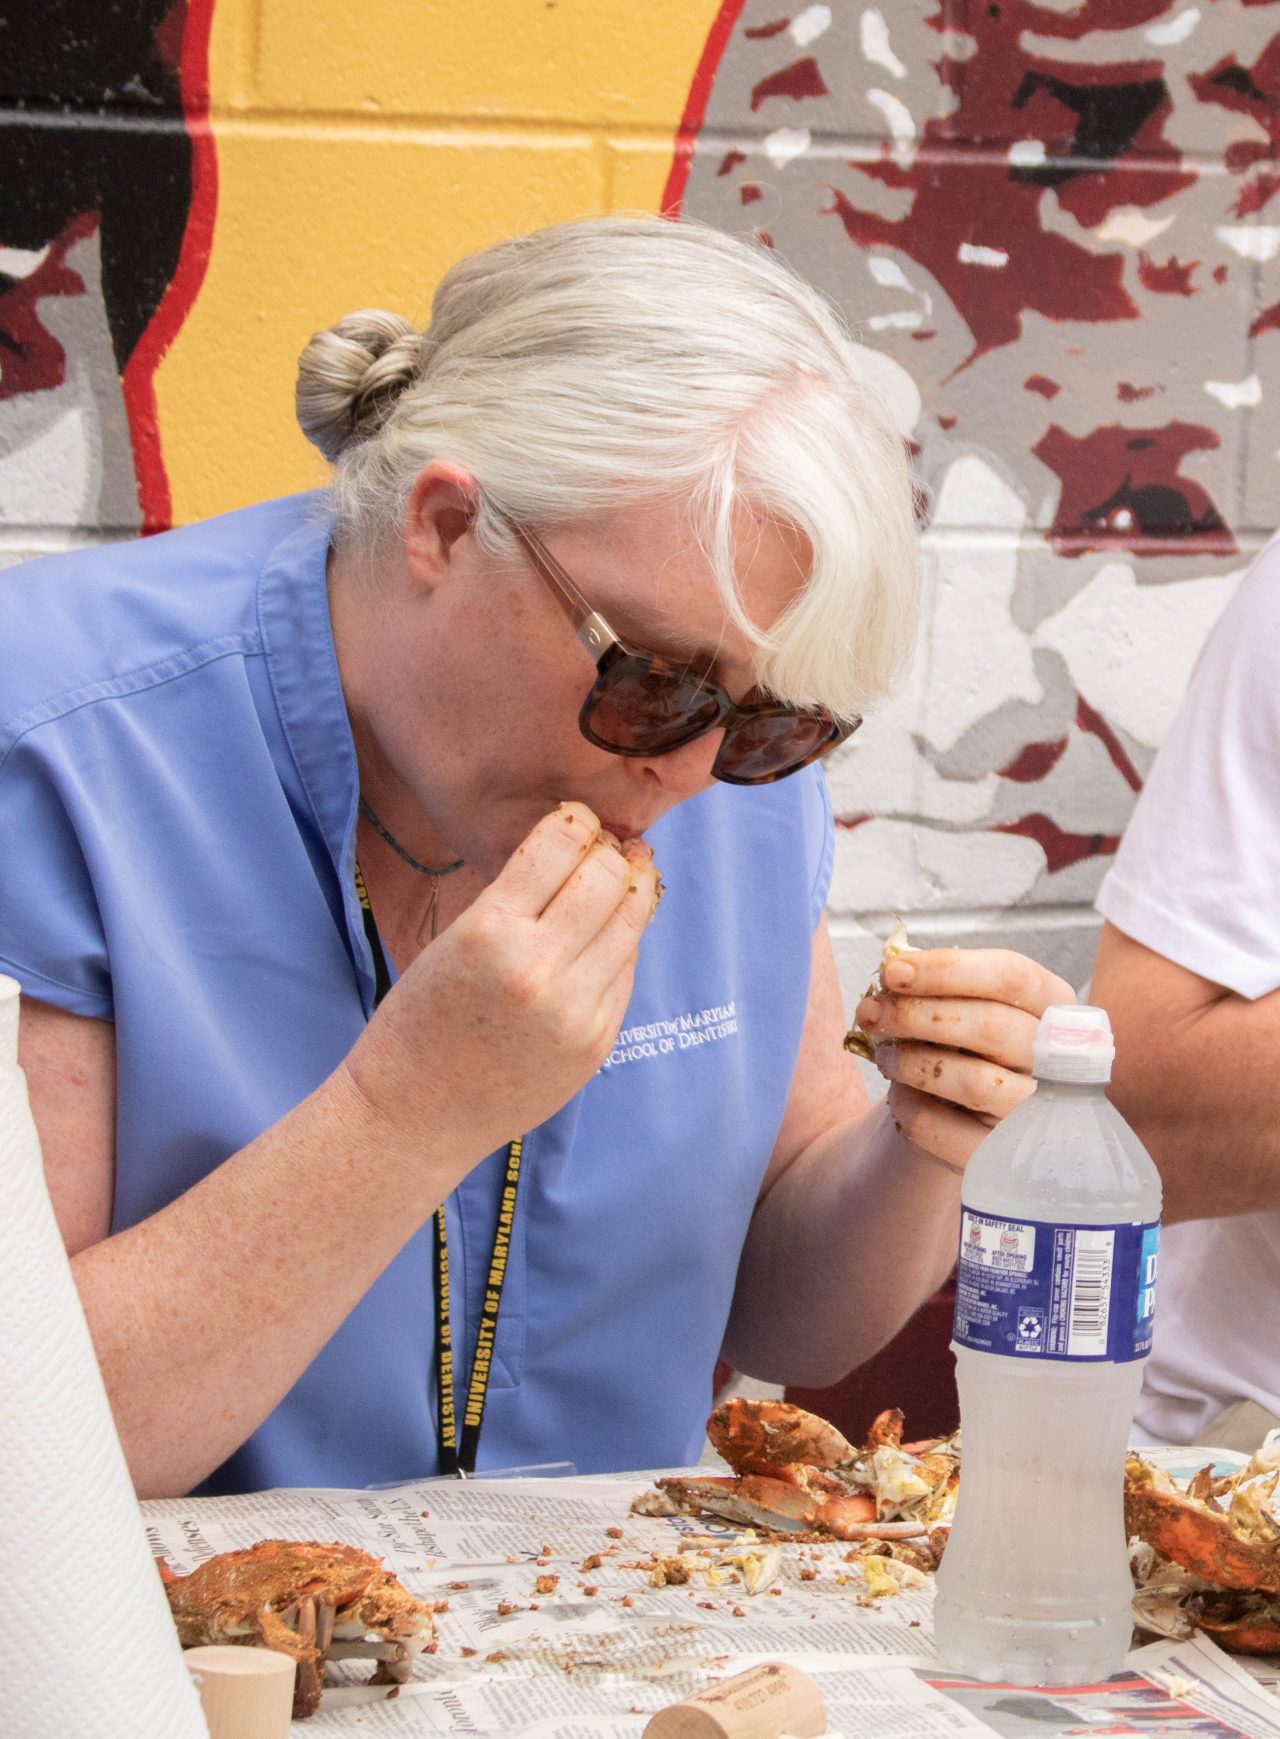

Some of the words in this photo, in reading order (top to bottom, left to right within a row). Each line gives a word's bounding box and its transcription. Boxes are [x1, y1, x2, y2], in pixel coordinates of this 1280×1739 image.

[659, 1037, 676, 1053] OF
[507, 1136, 523, 1181] SCH
[489, 1186, 516, 1286] MARYLAND
[985, 1219, 1006, 1230] SAFETY
[1008, 1223, 1024, 1233] SEAL
[1102, 1259, 1110, 1292] 54333
[484, 1289, 500, 1313] OF
[1100, 1296, 1108, 1326] 82657
[465, 1316, 495, 1427] UNIVERSITY
[441, 1350, 456, 1448] DENTISTRY
